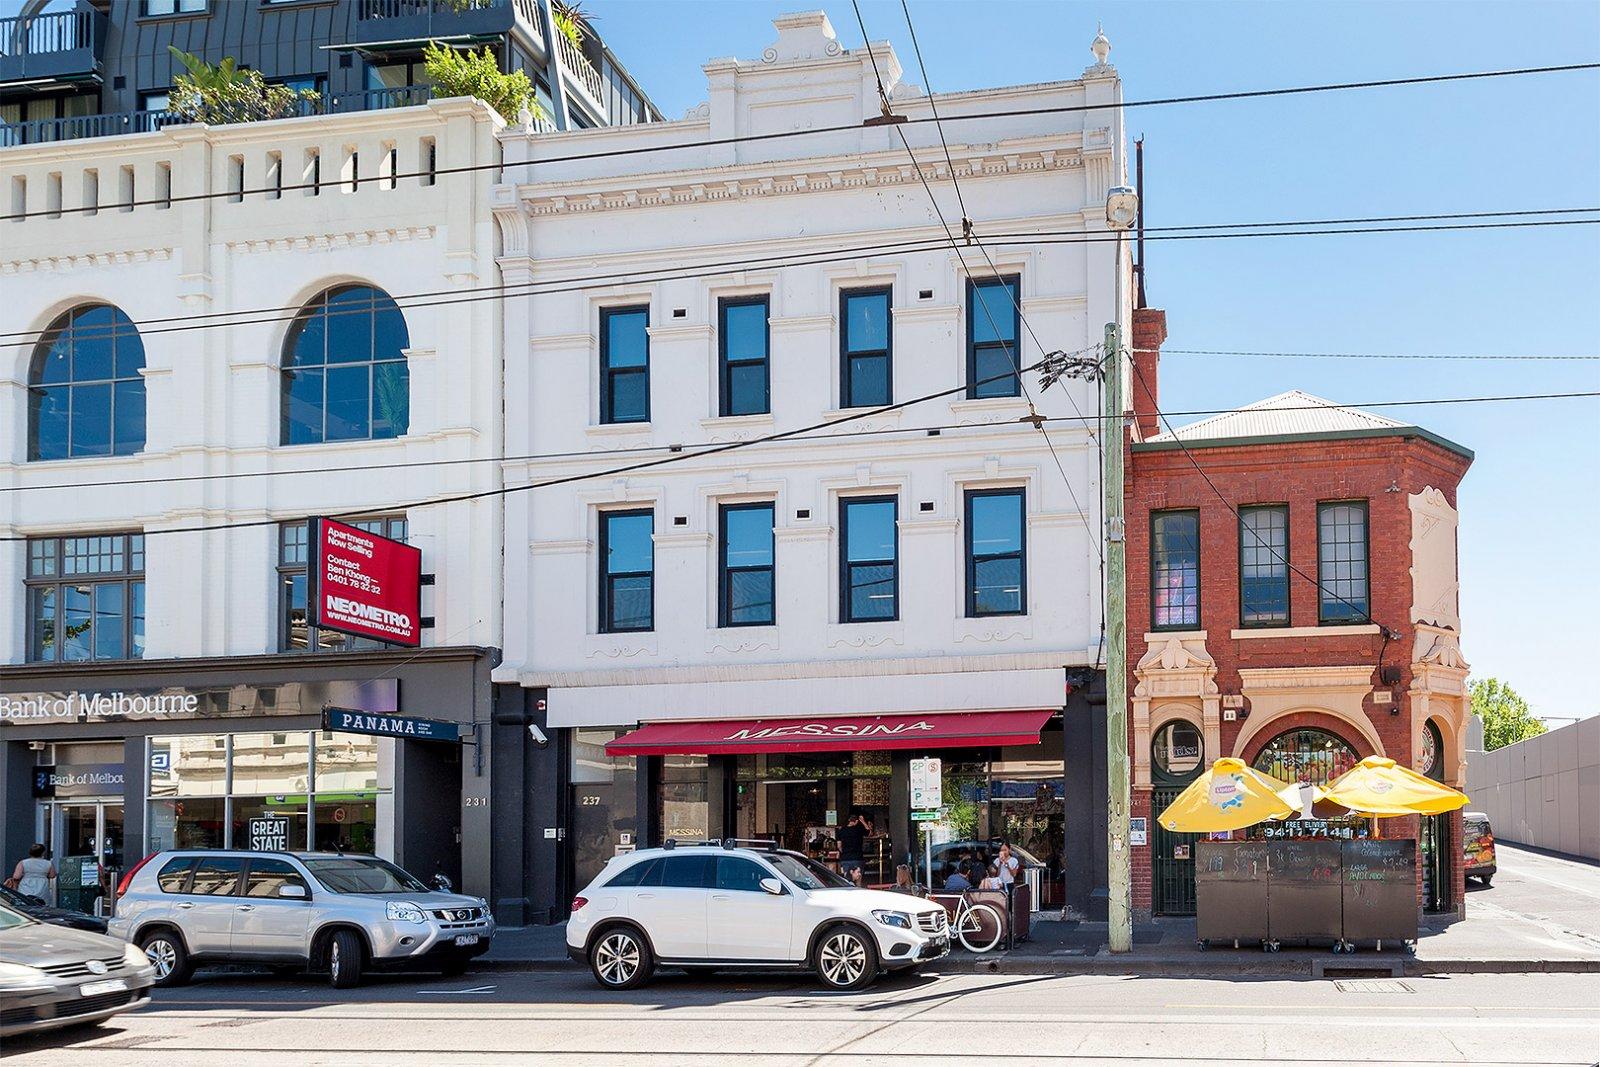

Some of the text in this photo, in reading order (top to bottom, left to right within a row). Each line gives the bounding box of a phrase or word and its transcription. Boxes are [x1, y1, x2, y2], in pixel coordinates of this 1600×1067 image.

[328, 527, 374, 549] Apartments
[328, 537, 373, 559] Now Selling
[327, 554, 360, 570] Contact
[327, 563, 345, 575] Ben
[327, 573, 381, 595] 0401 78 32 32
[327, 611, 411, 637] WWW.NEOMETRO.COM.AU
[0, 692, 198, 718] Bank of Melbourne
[343, 713, 415, 734] PANAMA
[723, 720, 935, 740] MESSINA
[912, 761, 924, 771] 2P
[50, 774, 75, 785] Bank
[77, 773, 88, 784] of
[466, 797, 487, 807] 231
[582, 797, 600, 805] 237
[264, 811, 275, 819] THE
[252, 821, 286, 835] GREAT
[669, 828, 704, 836] MESSINA
[1286, 821, 1301, 829] FREE
[1264, 828, 1303, 837] 9417
[252, 836, 286, 851] STATE
